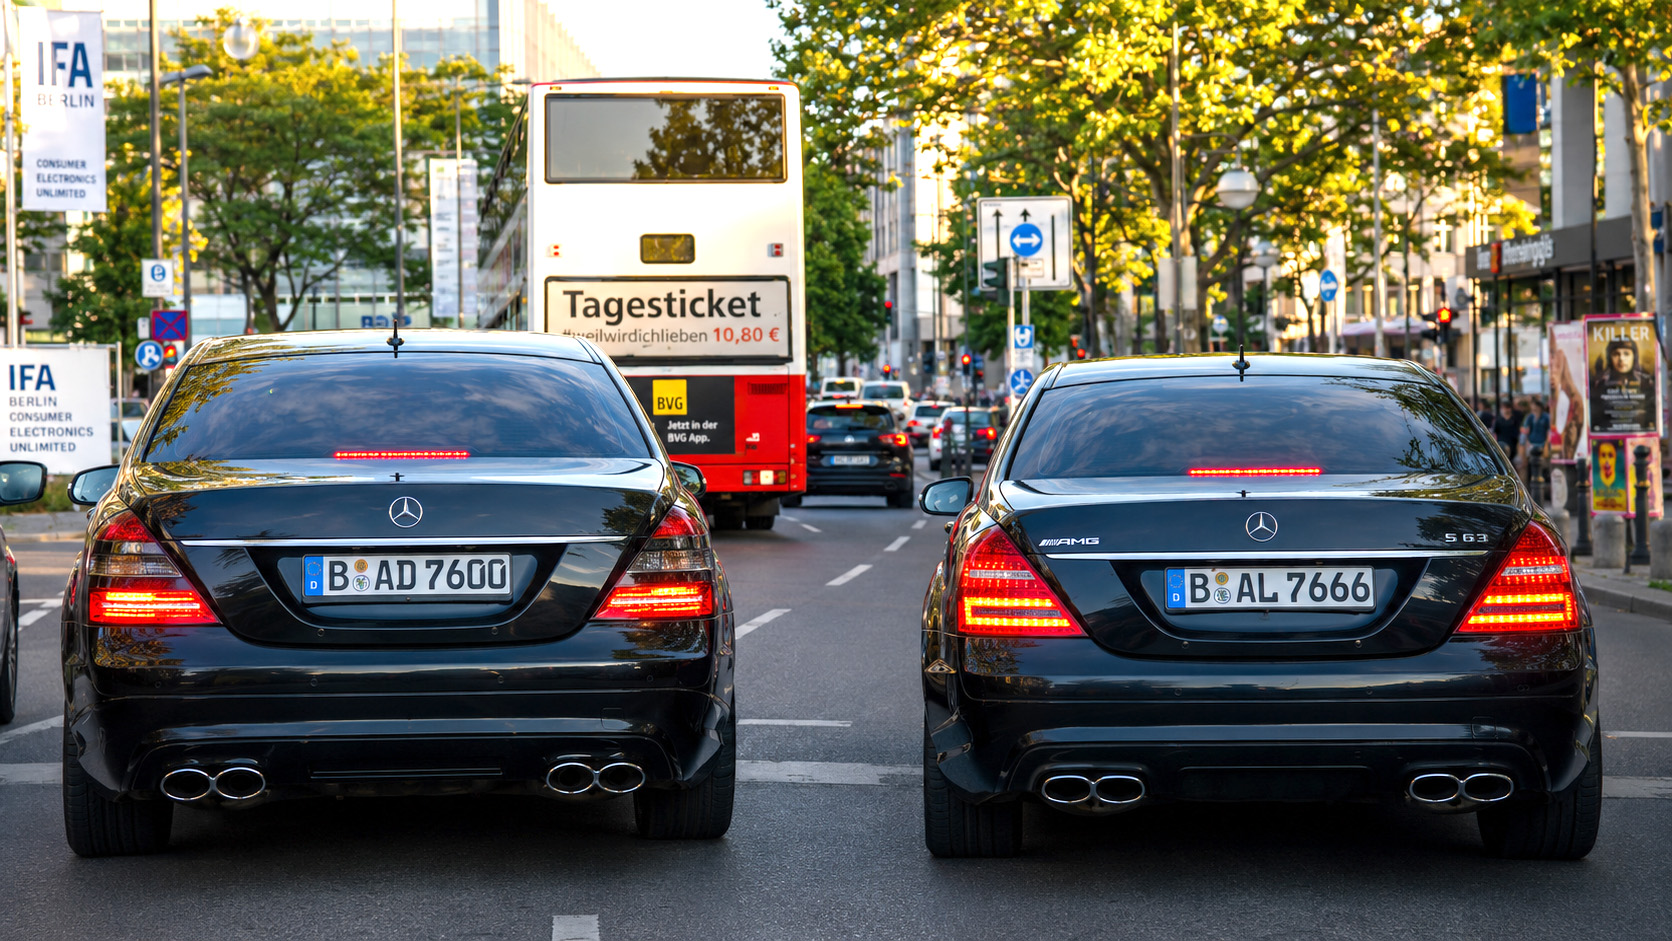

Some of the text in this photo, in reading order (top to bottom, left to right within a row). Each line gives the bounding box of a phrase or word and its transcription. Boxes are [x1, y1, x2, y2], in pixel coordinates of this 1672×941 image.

[38, 42, 93, 88] IFA
[36, 158, 86, 169] CONSUMER
[36, 173, 96, 184] ELECTRONICS
[36, 188, 86, 198] UNLIMITED
[562, 288, 761, 326] Tagesticket
[713, 327, 763, 344] 10,80
[769, 327, 780, 342] €
[1593, 326, 1650, 342] KILLER
[9, 364, 56, 391] IFA
[9, 396, 57, 407] BERLIN
[657, 397, 683, 410] BVG
[9, 412, 72, 422] CONSUMER
[667, 420, 718, 430] Jetzt in der
[10, 427, 94, 437] ELECTRONICS
[668, 433, 710, 444] BVG App.
[10, 442, 76, 452] UNLIMITED
[1054, 537, 1100, 546] AMG
[1445, 533, 1489, 543] S 63
[329, 559, 505, 591] B AD 7600
[310, 580, 318, 590] D
[1190, 572, 1370, 604] B AL 7666
[1172, 593, 1180, 602] D
